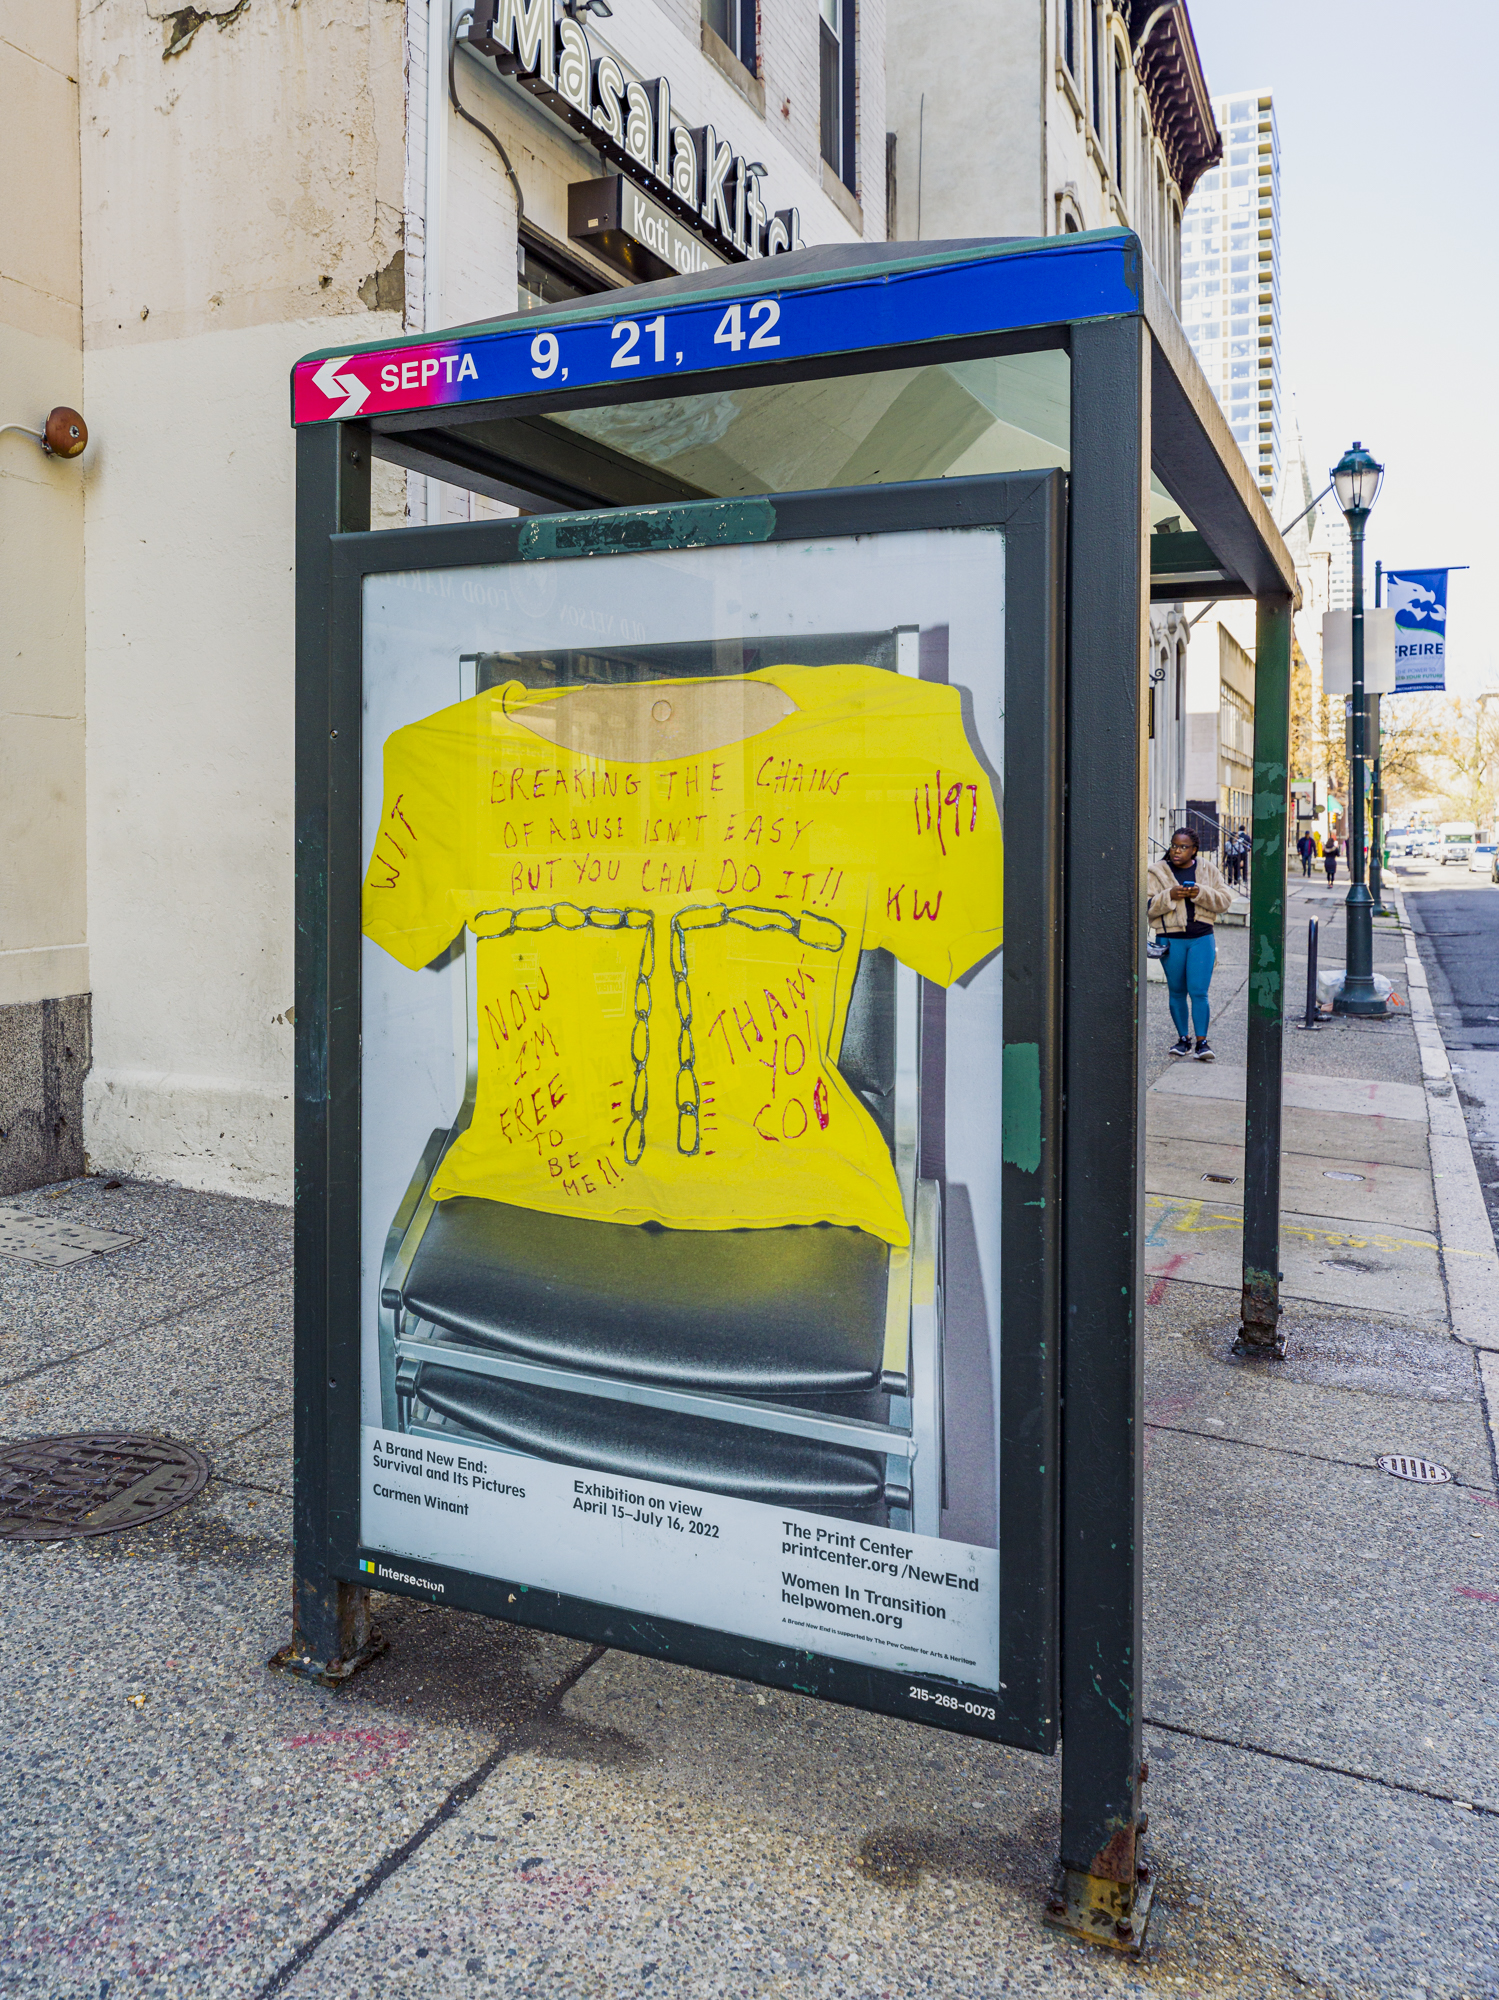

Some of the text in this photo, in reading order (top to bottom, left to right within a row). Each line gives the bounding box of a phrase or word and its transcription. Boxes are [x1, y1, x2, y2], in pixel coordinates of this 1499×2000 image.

[634, 195, 670, 259] Kati
[380, 299, 781, 392] SEPTA 9, 21, 42
[490, 756, 849, 804] BREAKING THE CHAINS
[503, 810, 814, 850] OF ABUSE ISN'T EASY
[511, 853, 843, 908] BUT YOU CAN DO IT!!
[484, 966, 550, 1050] NOW
[499, 1072, 568, 1144] FREE
[526, 1129, 564, 1156] TO
[548, 1151, 580, 1178] BE
[373, 1439, 488, 1474] A Brand New End:
[373, 1455, 526, 1498] Survival and Its Pictures
[373, 1483, 469, 1516] Carmen Winant
[573, 1479, 703, 1517] Exhibition on view
[573, 1497, 607, 1516] April
[667, 1515, 685, 1533] 16,
[688, 1520, 720, 1539] 2022
[782, 1521, 913, 1560] The Print Center
[378, 1564, 445, 1594] Intersection
[782, 1571, 947, 1619] Women In Transition
[781, 1589, 903, 1629] helpwomen.org
[787, 1618, 805, 1627] Brand
[806, 1622, 818, 1630] New
[819, 1625, 831, 1633] End
[837, 1630, 865, 1640] supported
[866, 1635, 874, 1643] by
[874, 1637, 886, 1645] The
[886, 1640, 899, 1648] Pew
[900, 1643, 920, 1653] Center
[930, 1650, 943, 1658] Arts
[949, 1655, 977, 1667] Heritage
[909, 1686, 996, 1721] 215-268-0073
